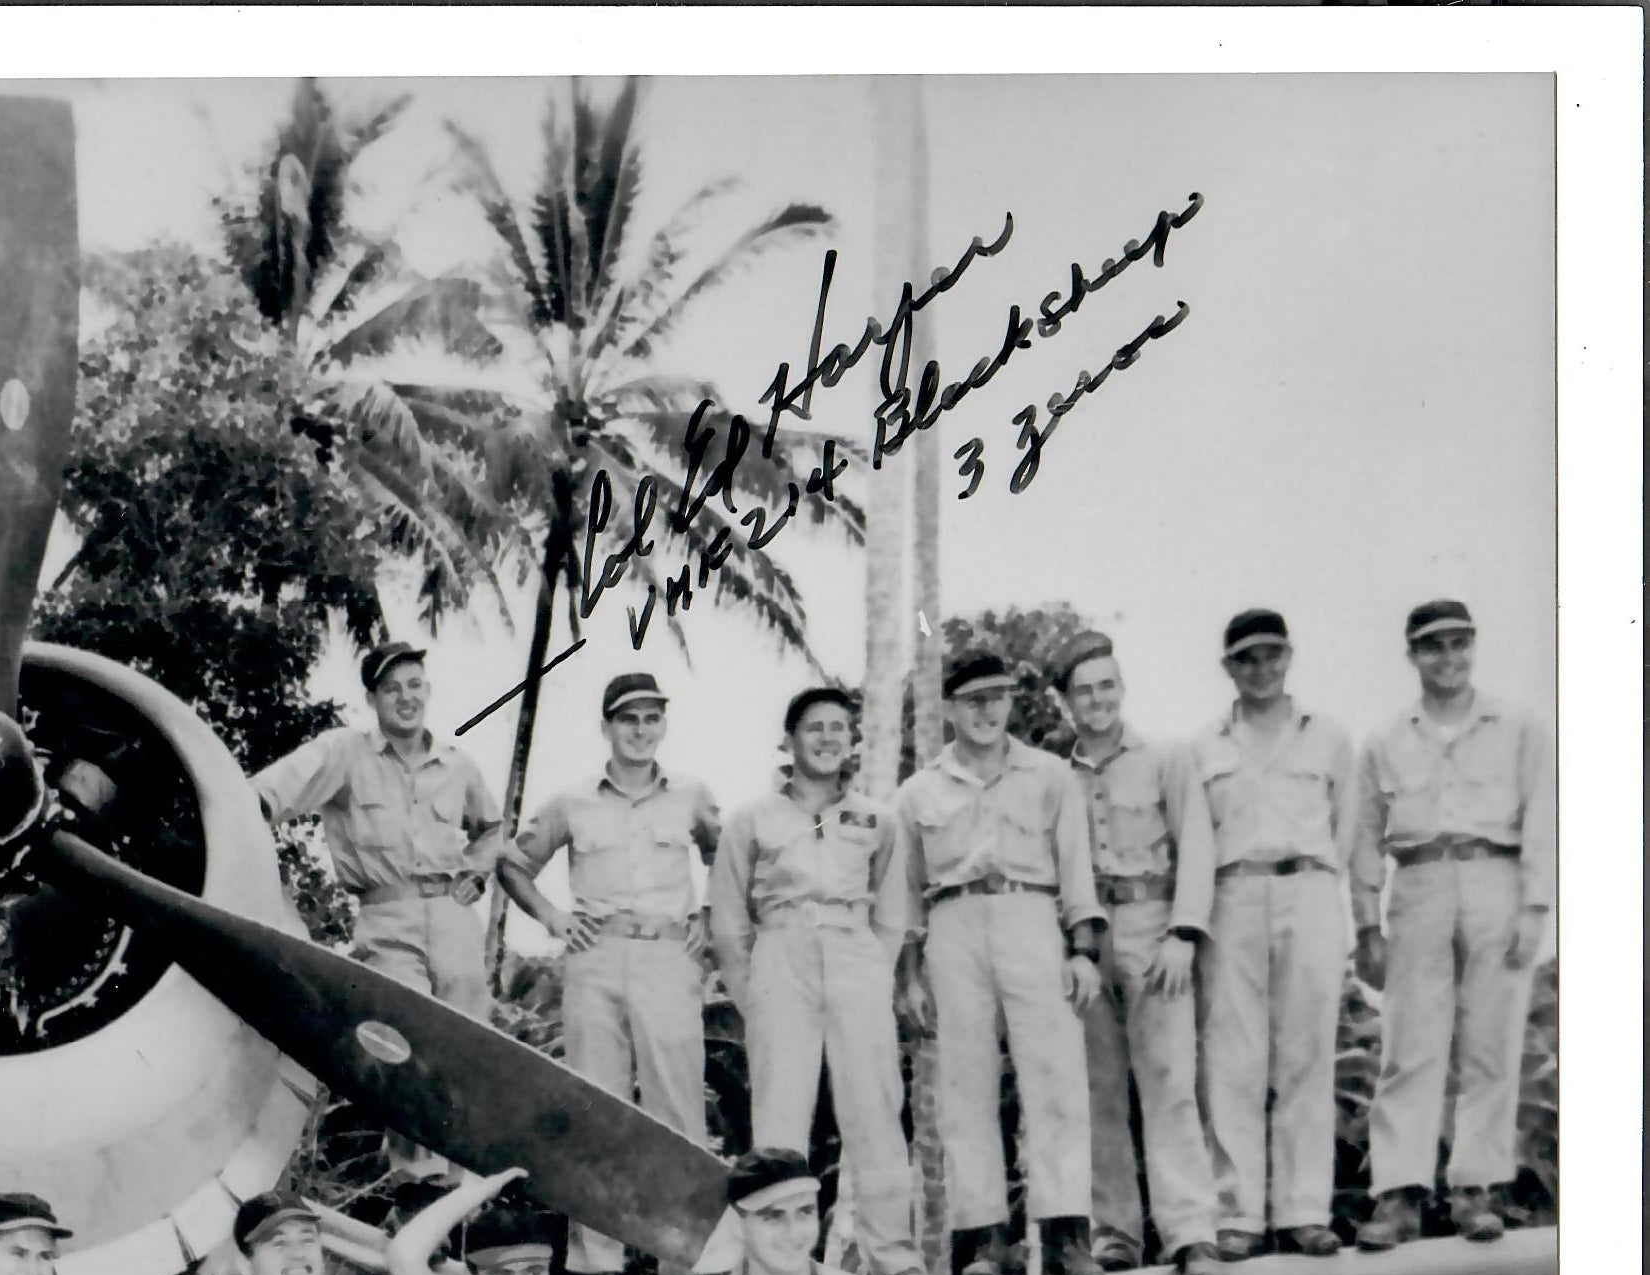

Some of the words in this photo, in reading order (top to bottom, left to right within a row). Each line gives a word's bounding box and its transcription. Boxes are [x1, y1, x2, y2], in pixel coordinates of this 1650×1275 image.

[580, 470, 658, 618] Col
[758, 210, 1014, 459] Harper
[953, 437, 985, 500] 3
